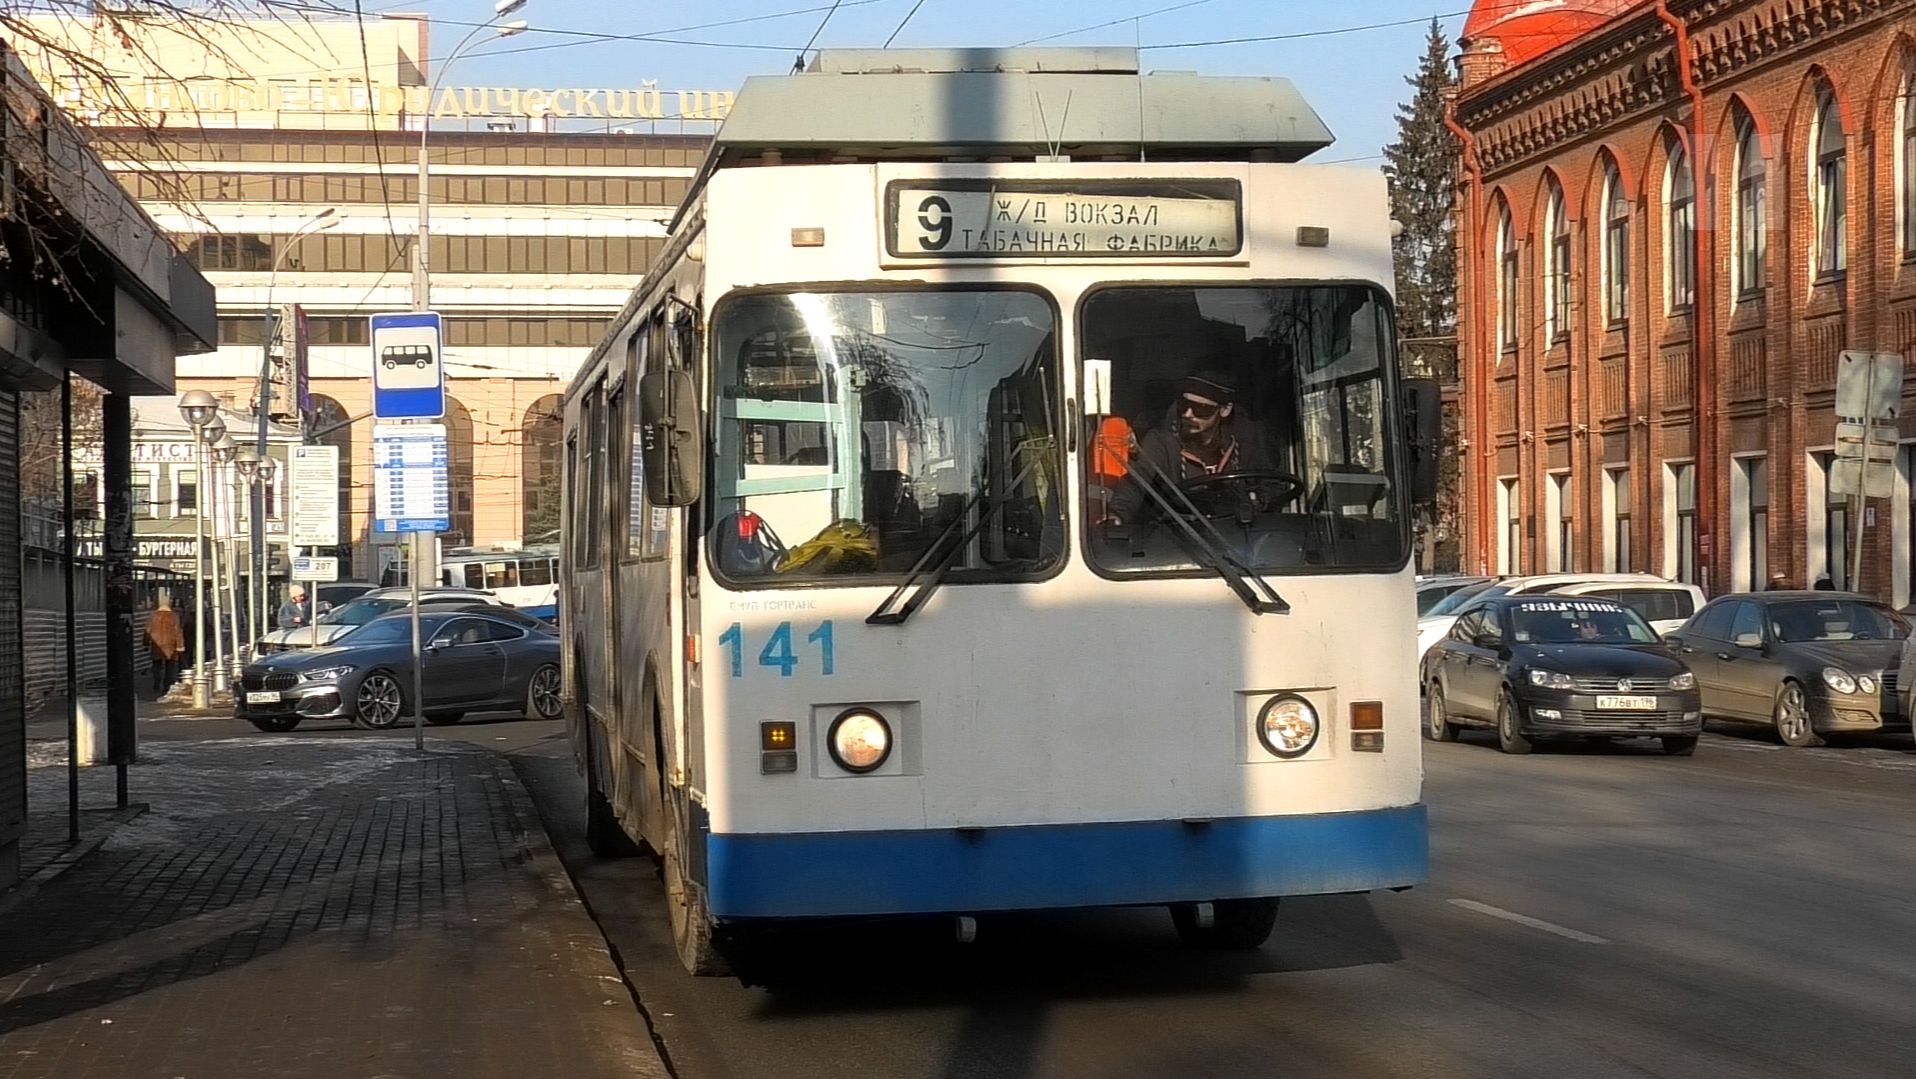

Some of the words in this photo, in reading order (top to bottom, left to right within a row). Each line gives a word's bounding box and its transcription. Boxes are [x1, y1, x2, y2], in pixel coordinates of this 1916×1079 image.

[918, 195, 952, 251] 9
[996, 199, 1047, 224] Ж/Д
[1065, 202, 1158, 226] ВОКЗАЛ
[962, 228, 1086, 251] ТАБАЧНАЯ
[1106, 233, 1218, 251] ФАБРИКА
[139, 541, 197, 556] БУРГЕРНАЯ
[763, 599, 817, 610] ГОРТРАНС
[718, 619, 833, 677] 141
